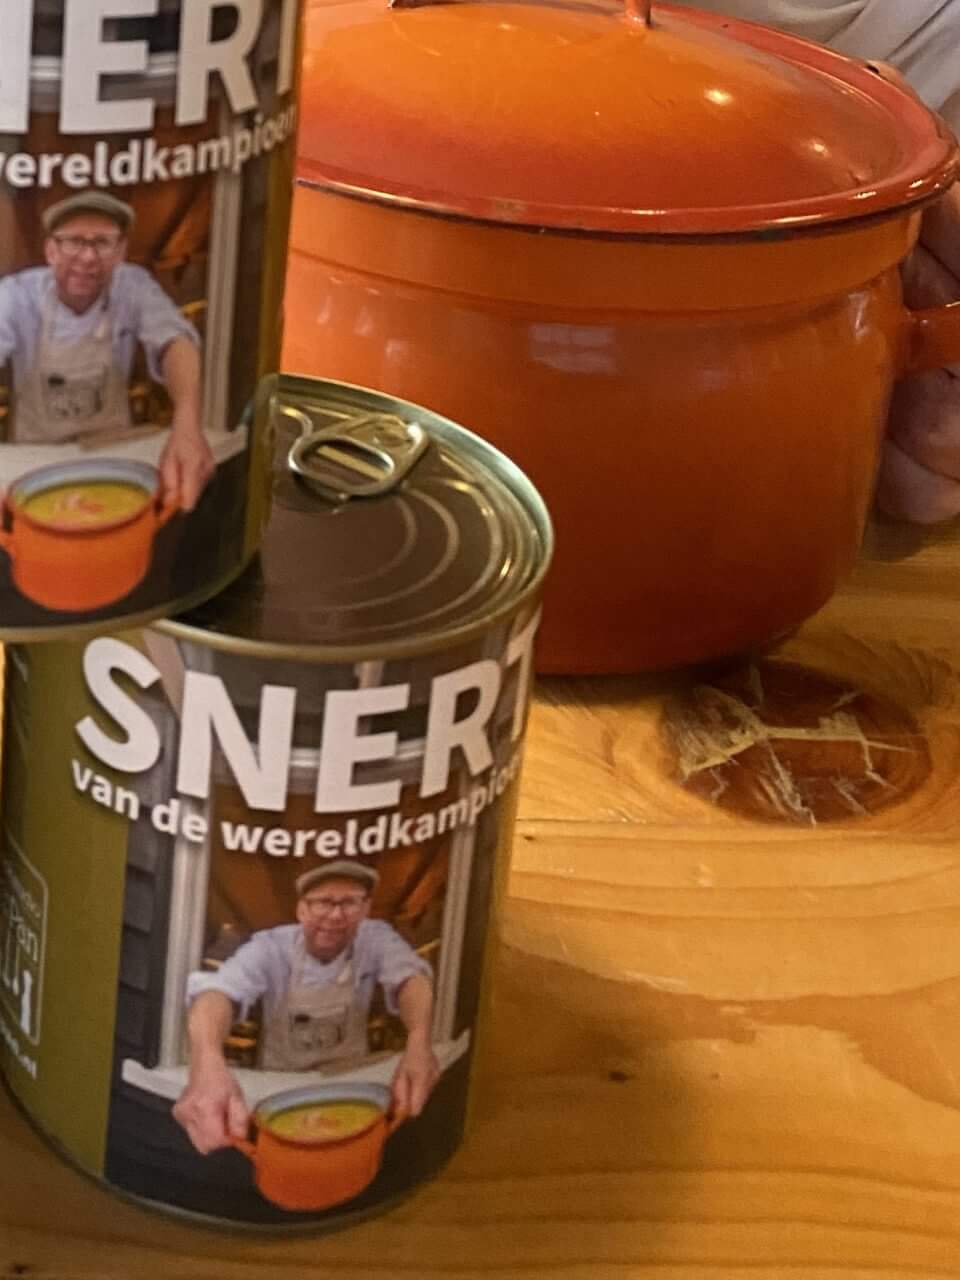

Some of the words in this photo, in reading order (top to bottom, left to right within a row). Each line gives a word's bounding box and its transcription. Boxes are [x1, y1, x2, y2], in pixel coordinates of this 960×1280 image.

[75, 602, 543, 813] SNERT
[71, 759, 141, 821] van
[150, 797, 209, 844] de
